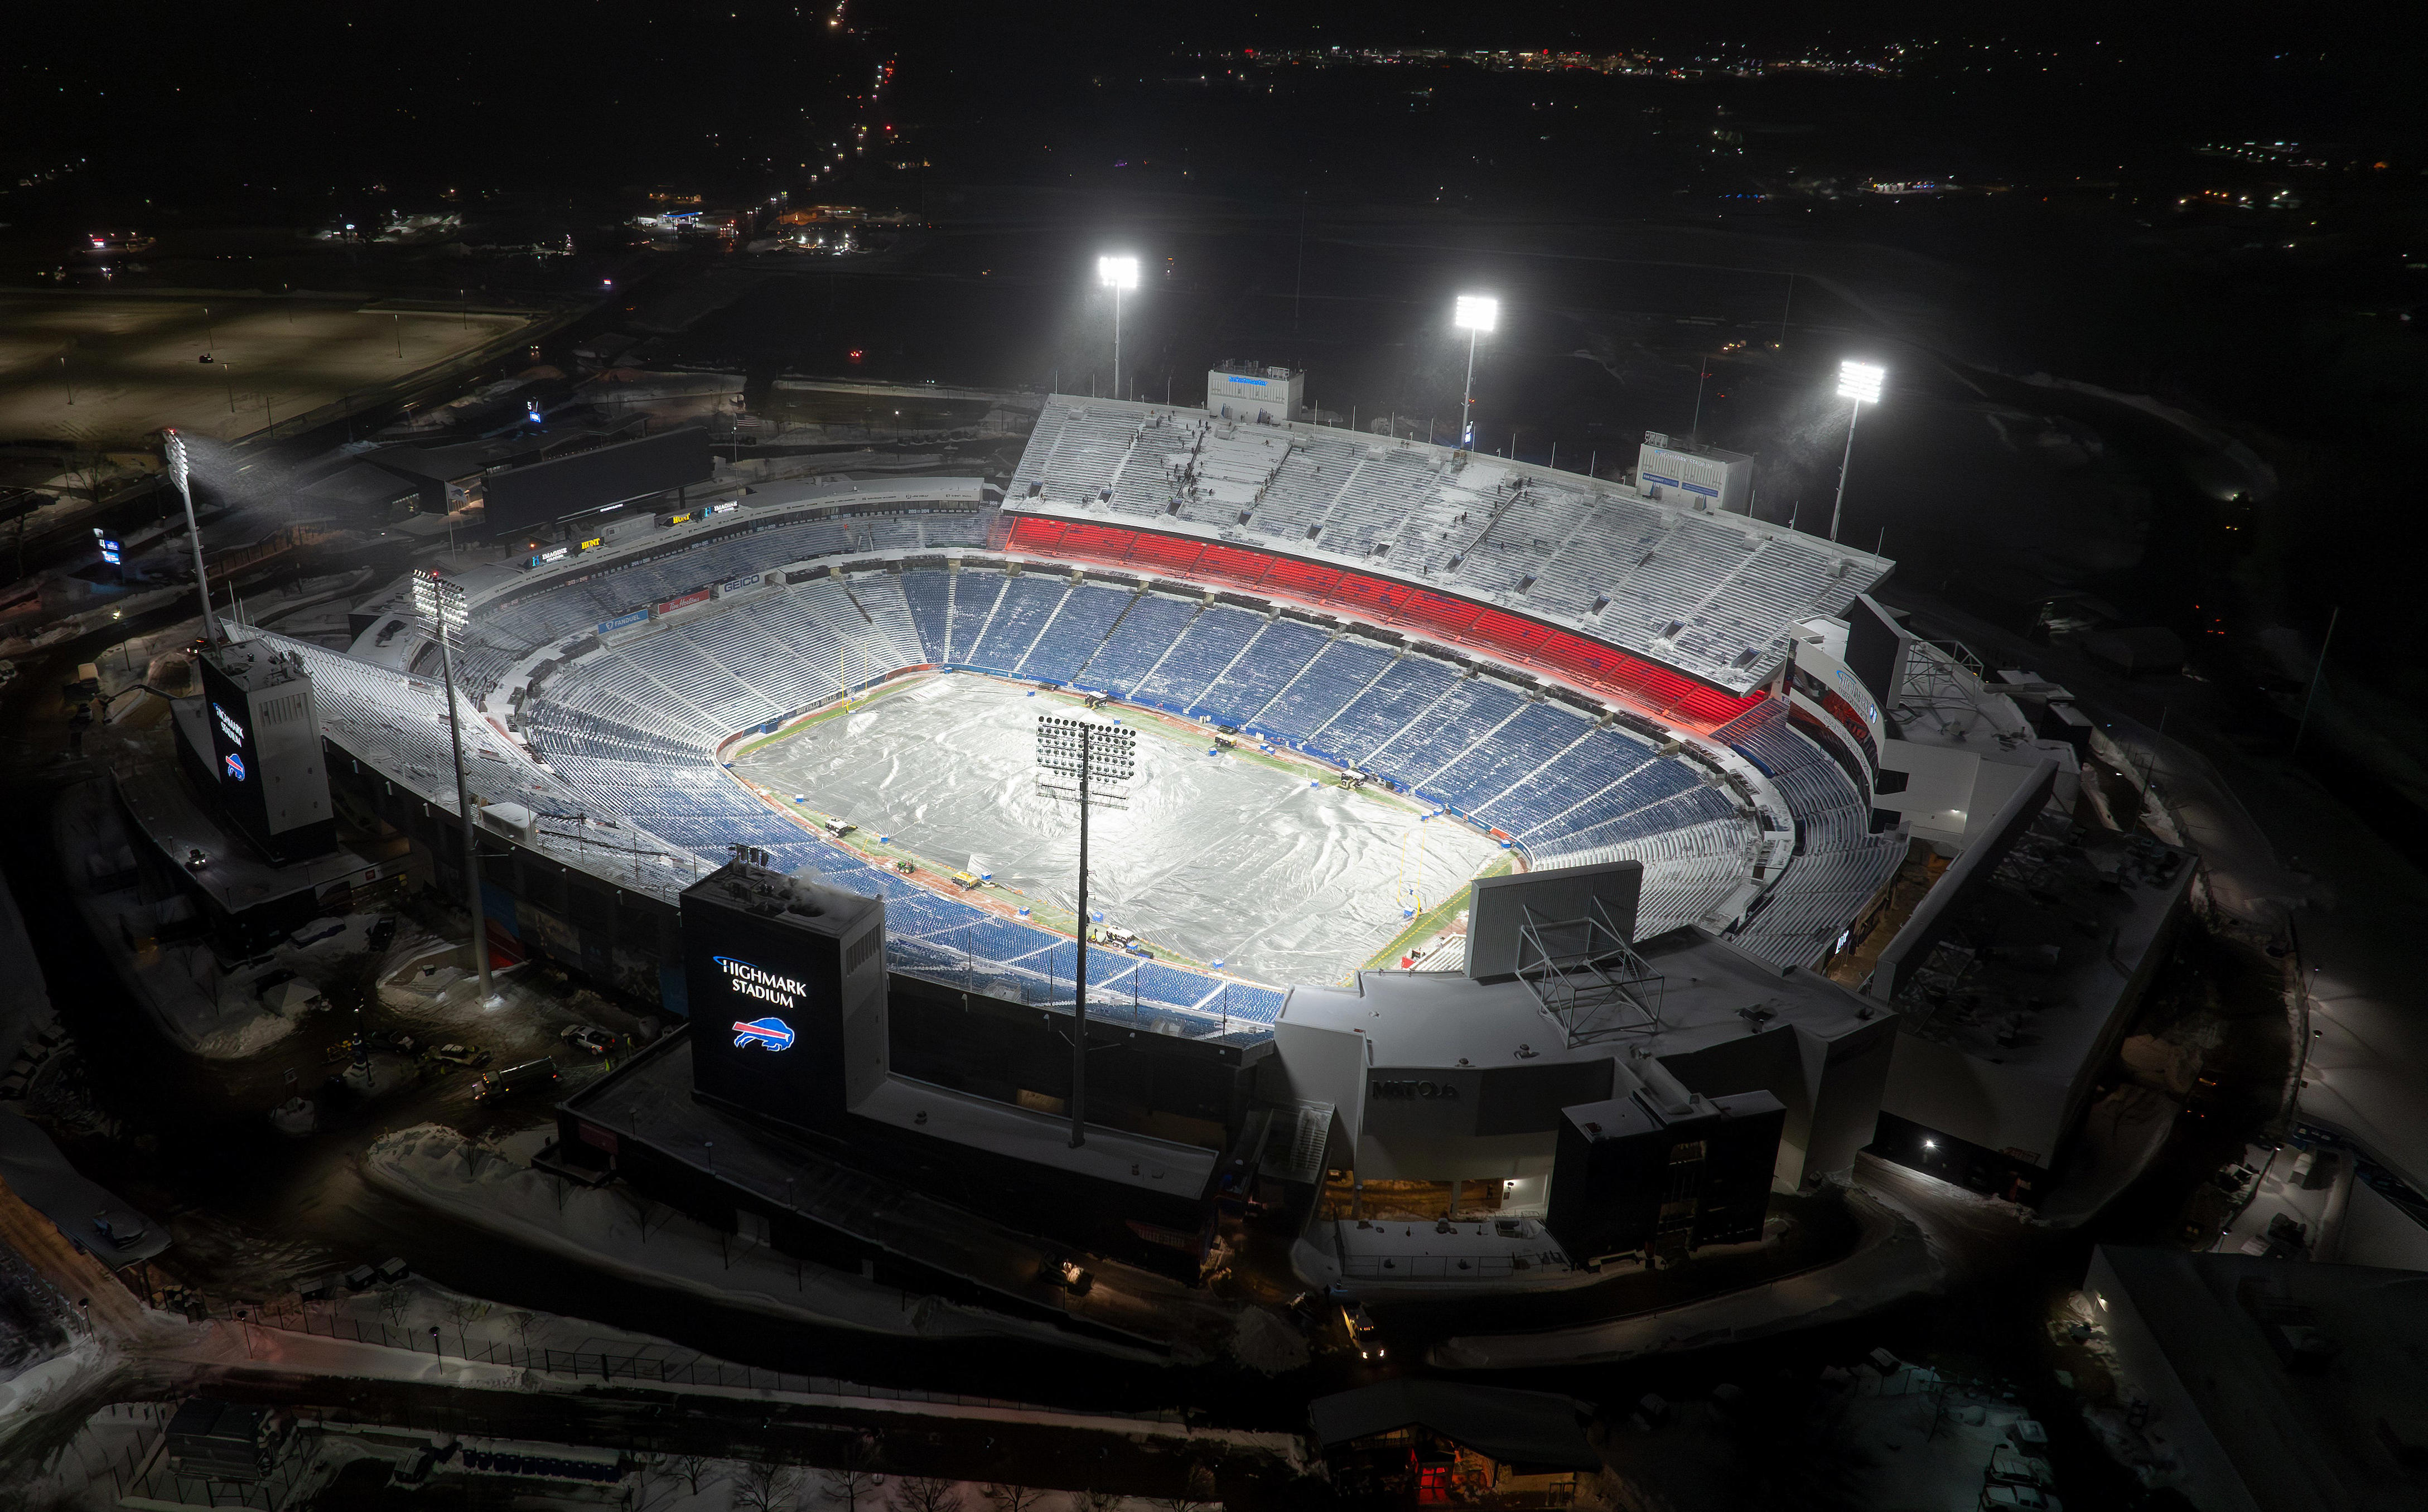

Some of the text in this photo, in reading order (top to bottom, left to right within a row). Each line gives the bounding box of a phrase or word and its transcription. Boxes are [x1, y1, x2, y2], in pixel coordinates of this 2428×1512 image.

[527, 402, 532, 410] 5
[1659, 452, 1713, 469] HIGHMARK STADIUM
[714, 501, 738, 511] IMAGINE
[673, 513, 691, 524] HUNT
[581, 538, 600, 550] HUNT
[542, 548, 567, 560] IMAGINE
[724, 574, 760, 593] GEICO
[669, 596, 700, 611] Tim Hortons
[615, 615, 640, 627] FANDUEL
[1839, 673, 1870, 713] HIGHMARK
[796, 695, 837, 714] BUFFALO BILLS
[215, 705, 244, 739] HIGHMARK
[221, 721, 242, 748] STADIUM
[723, 959, 807, 997] HIGHMARK
[732, 978, 794, 1008] STADIUM
